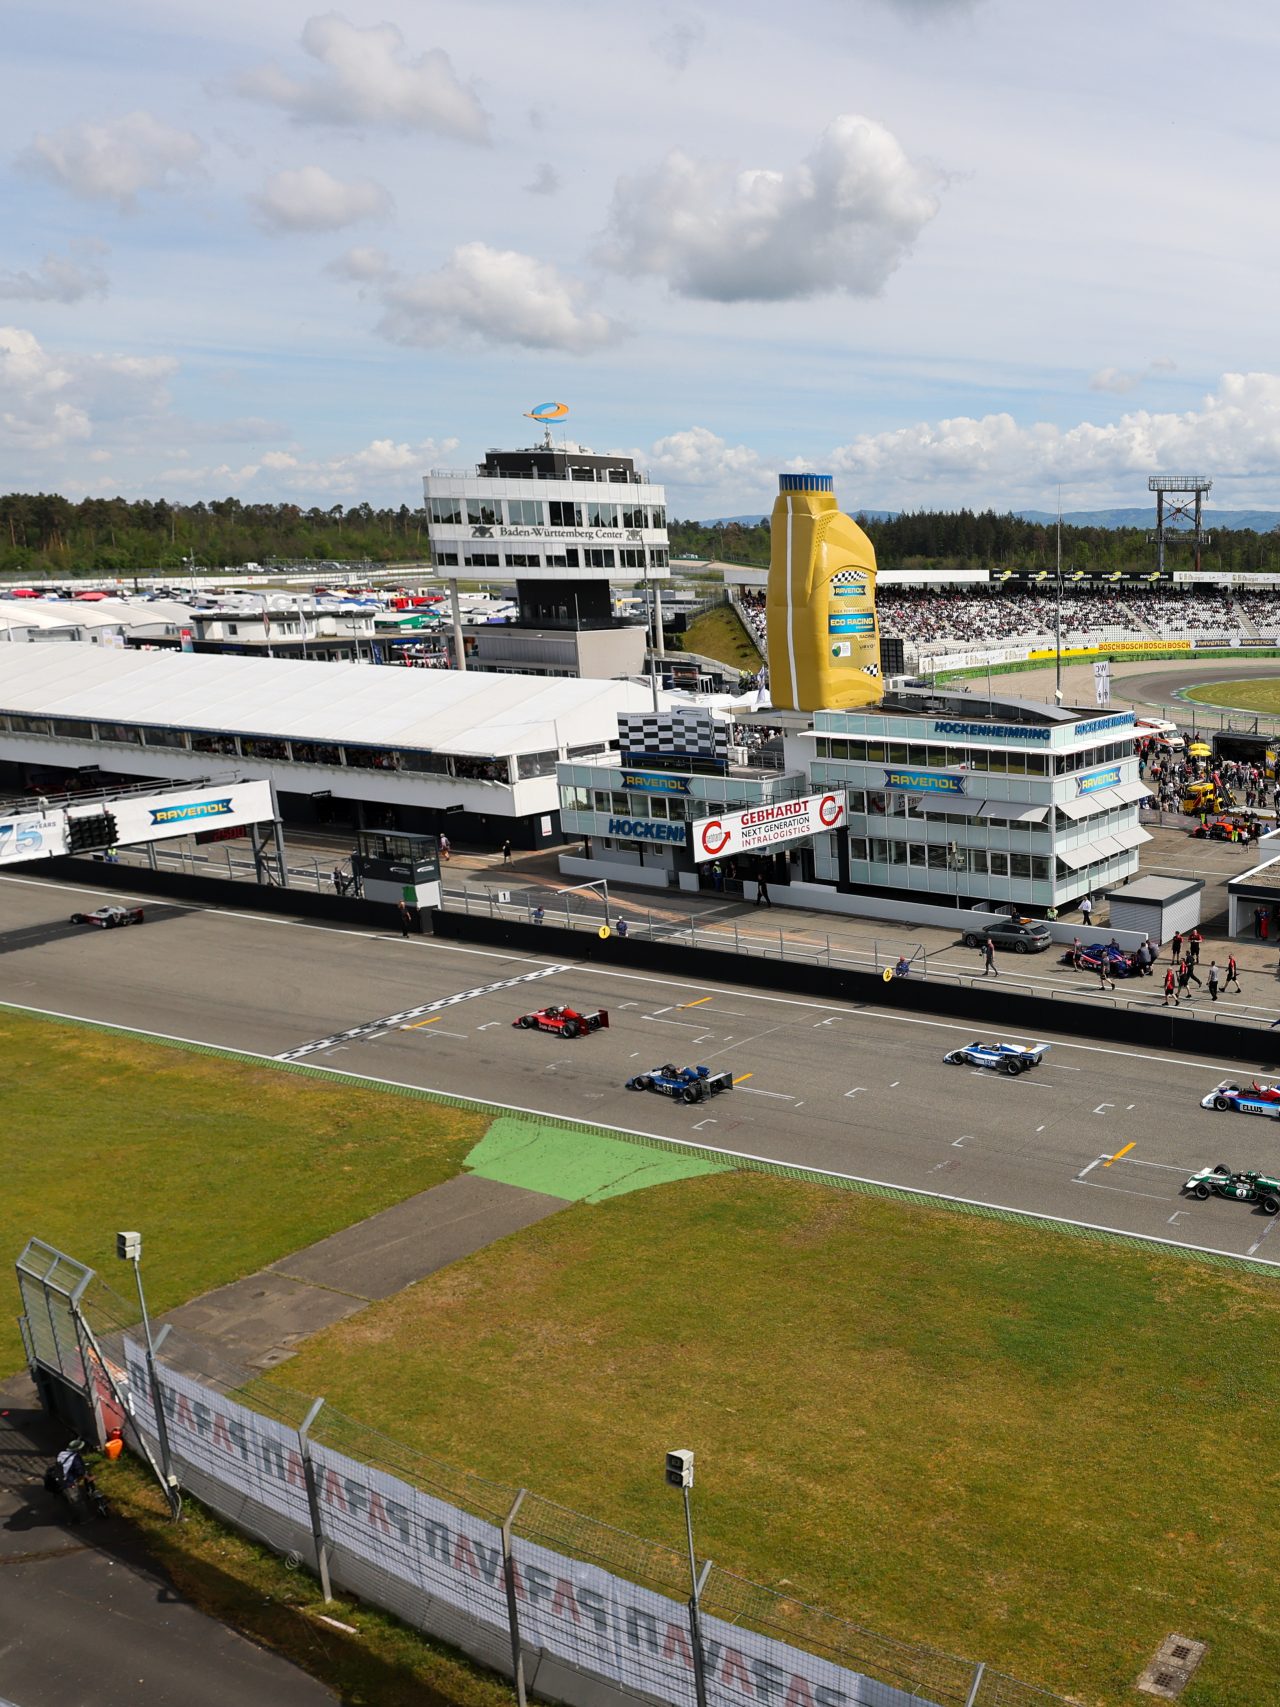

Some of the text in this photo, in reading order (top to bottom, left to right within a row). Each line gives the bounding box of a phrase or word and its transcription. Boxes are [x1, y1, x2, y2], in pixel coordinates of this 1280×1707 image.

[500, 527, 623, 541] Baden-Württemberg Center
[847, 617, 873, 625] RACING
[1098, 643, 1120, 651] BOSCH
[1144, 642, 1166, 650] BOSCH
[935, 722, 1050, 740] HOCKENHEIMRING
[1075, 711, 1135, 736] HOCKENHEIMRING
[626, 776, 685, 791] RAVENOL
[890, 774, 957, 790] RAVENOL
[1081, 771, 1119, 789] RAVENOL
[155, 802, 229, 822] RAVENOL
[741, 800, 809, 826] GEBHARDT
[741, 815, 810, 839] NEXT GENERATION
[741, 824, 810, 848] INTRALOGISTICS
